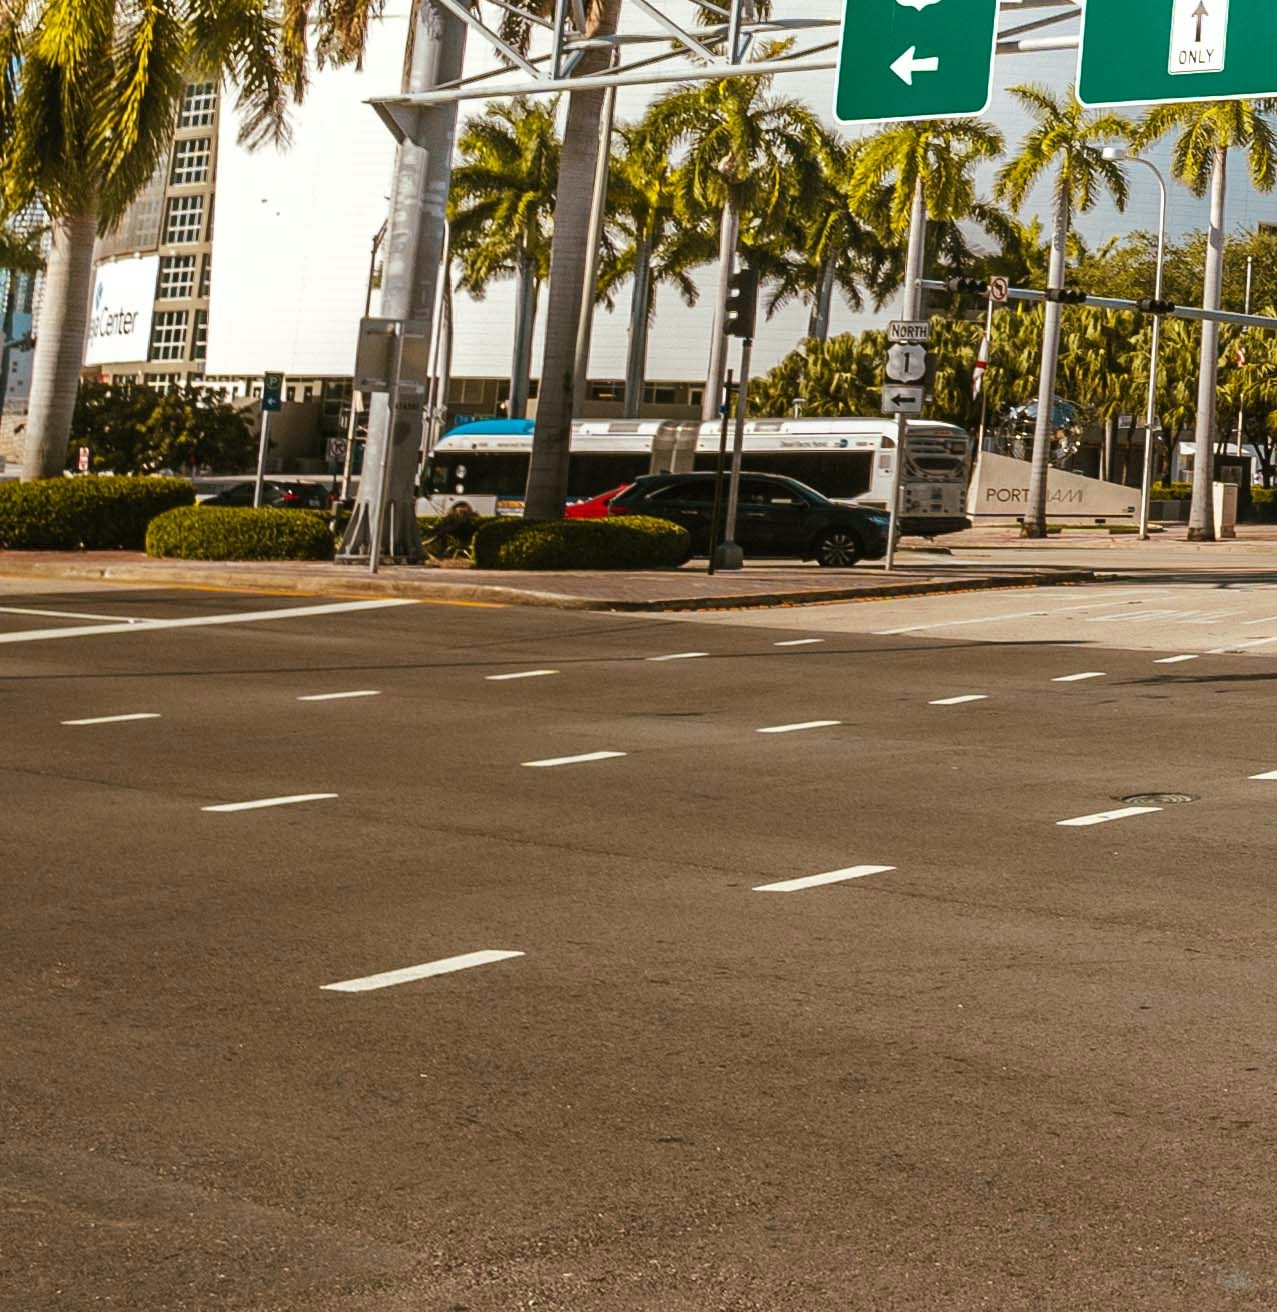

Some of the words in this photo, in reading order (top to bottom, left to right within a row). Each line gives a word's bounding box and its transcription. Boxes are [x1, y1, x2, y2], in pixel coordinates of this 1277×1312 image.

[1178, 47, 1215, 66] ONLY
[100, 305, 139, 337] Center
[891, 323, 927, 338] NORTH
[903, 351, 910, 373] 1
[986, 488, 1030, 503] PORT
